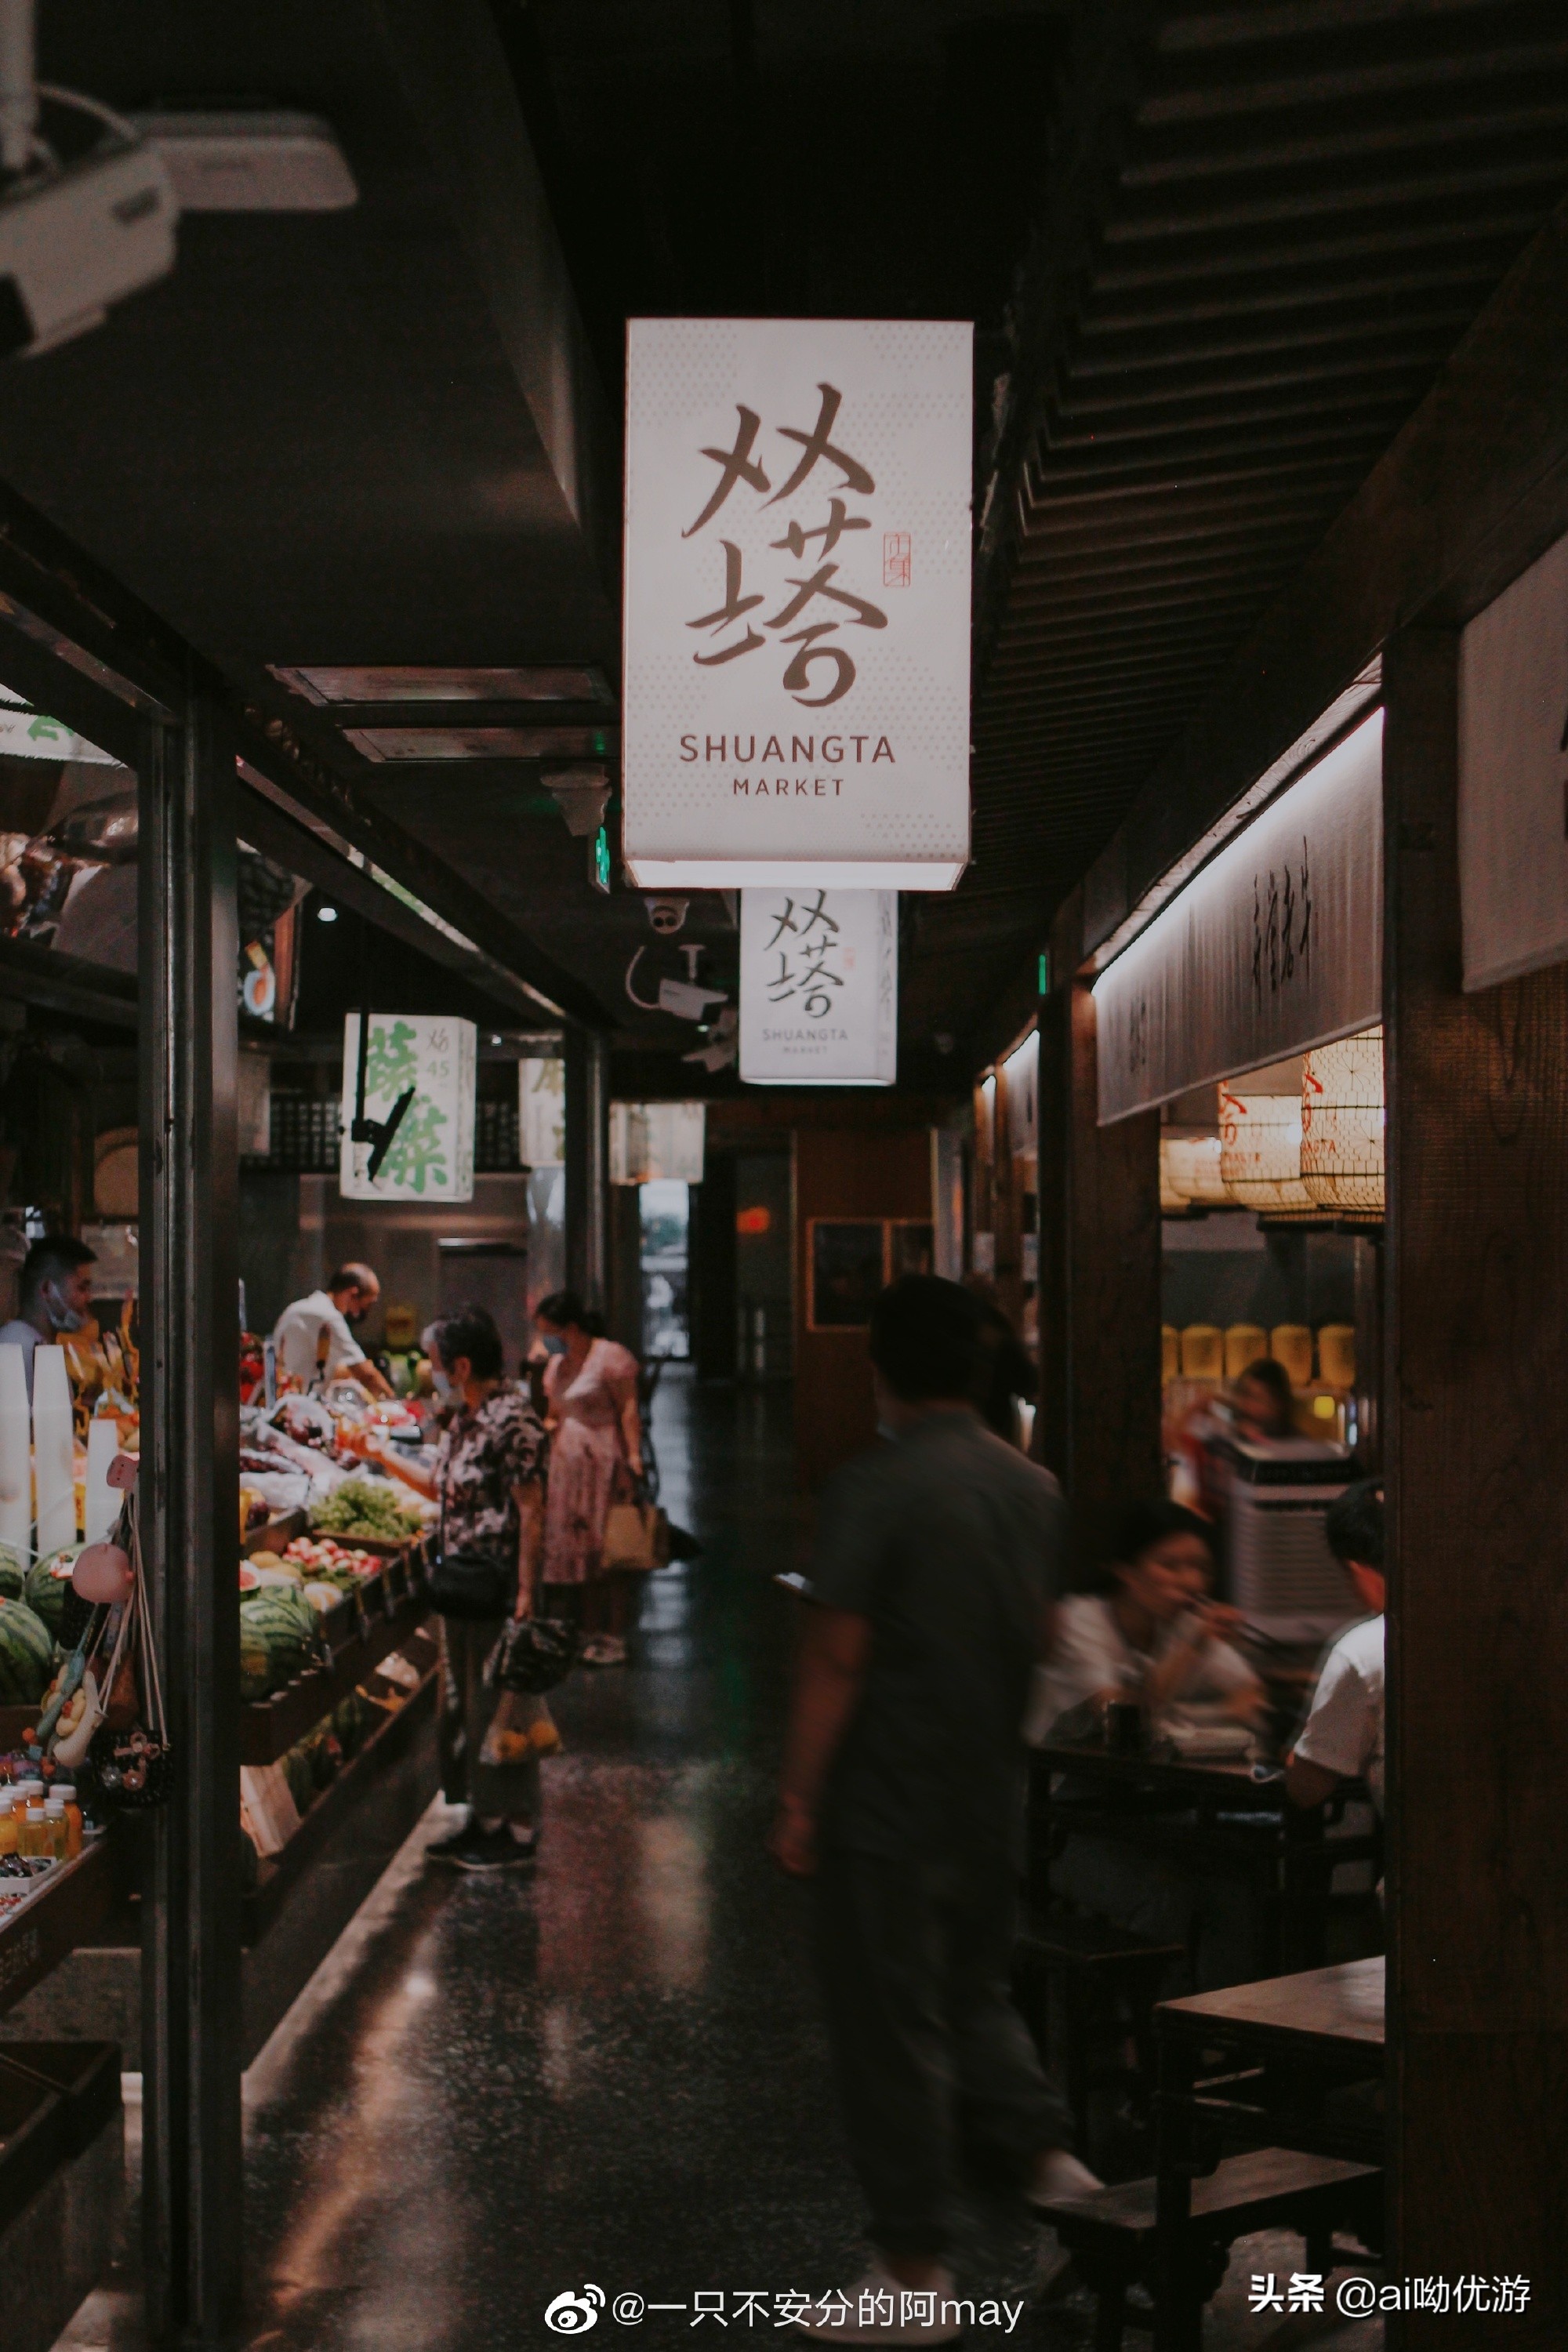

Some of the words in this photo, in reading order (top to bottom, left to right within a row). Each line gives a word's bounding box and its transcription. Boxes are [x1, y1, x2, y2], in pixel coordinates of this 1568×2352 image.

[681, 383, 888, 707] 双塔
[680, 735, 896, 764] SHUANGTA
[733, 779, 845, 797] MARKET
[762, 1028, 849, 1041] SHUANGTA
